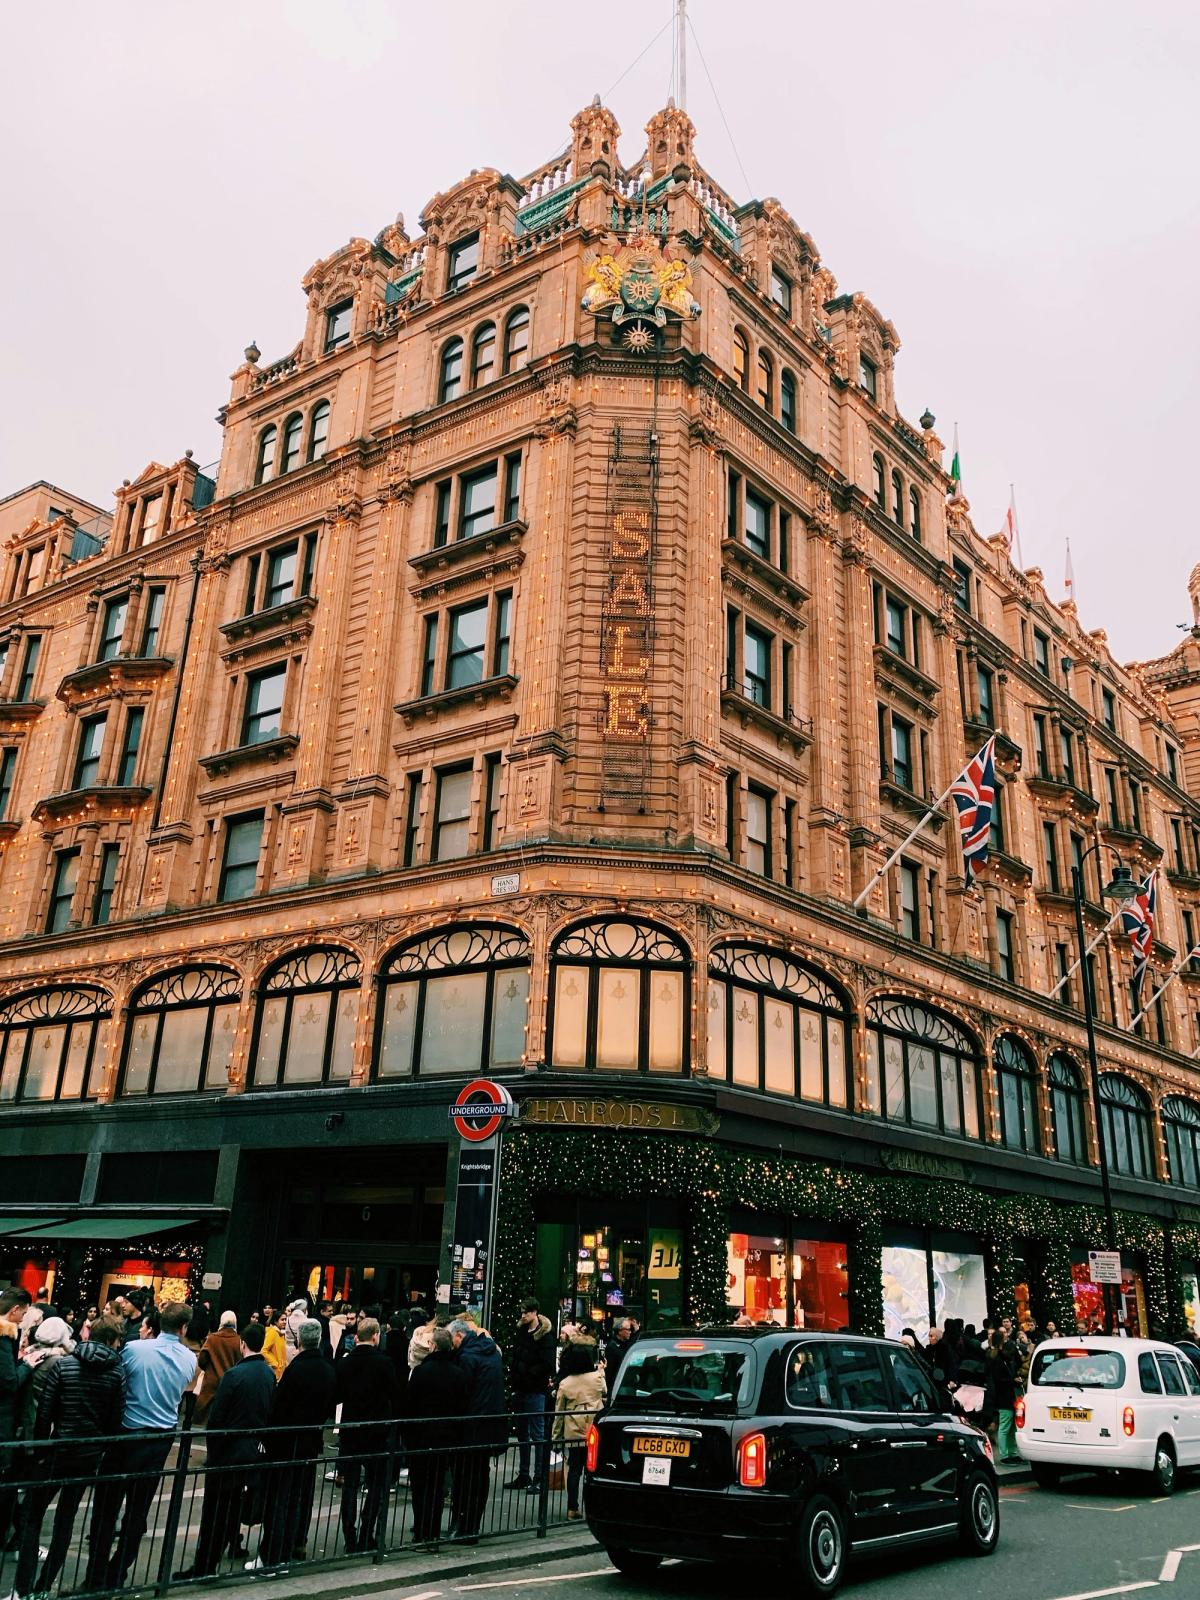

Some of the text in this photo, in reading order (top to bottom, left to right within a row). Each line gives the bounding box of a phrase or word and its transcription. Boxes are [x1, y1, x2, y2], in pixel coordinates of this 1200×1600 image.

[602, 511, 656, 737] SALE
[497, 879, 514, 887] HANS
[450, 1105, 506, 1115] UNDERGROUND
[533, 1099, 662, 1127] HARRODS
[460, 1163, 492, 1171] Knightsbridge
[1053, 1411, 1088, 1420] LT65 NMM
[637, 1438, 686, 1454] LC68 GXO
